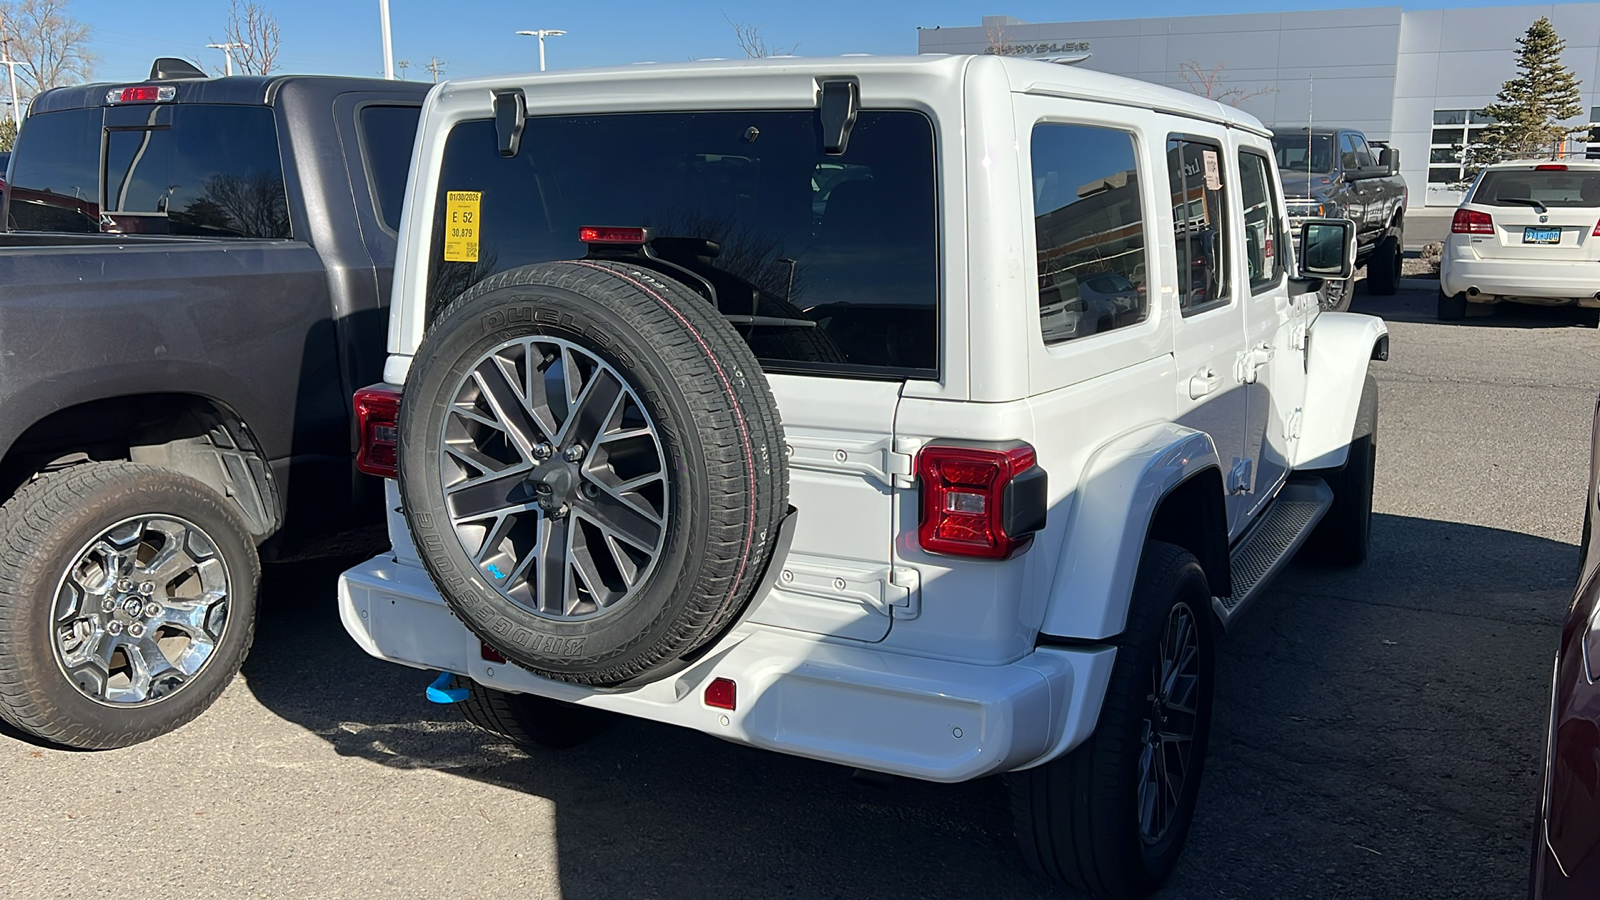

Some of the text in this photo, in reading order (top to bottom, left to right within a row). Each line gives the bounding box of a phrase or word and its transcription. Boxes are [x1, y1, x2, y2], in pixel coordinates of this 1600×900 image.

[451, 228, 472, 238] 30,879
[452, 211, 473, 223] E 52
[481, 306, 636, 370] DUELER
[415, 511, 588, 658] BRIDGESTONE
